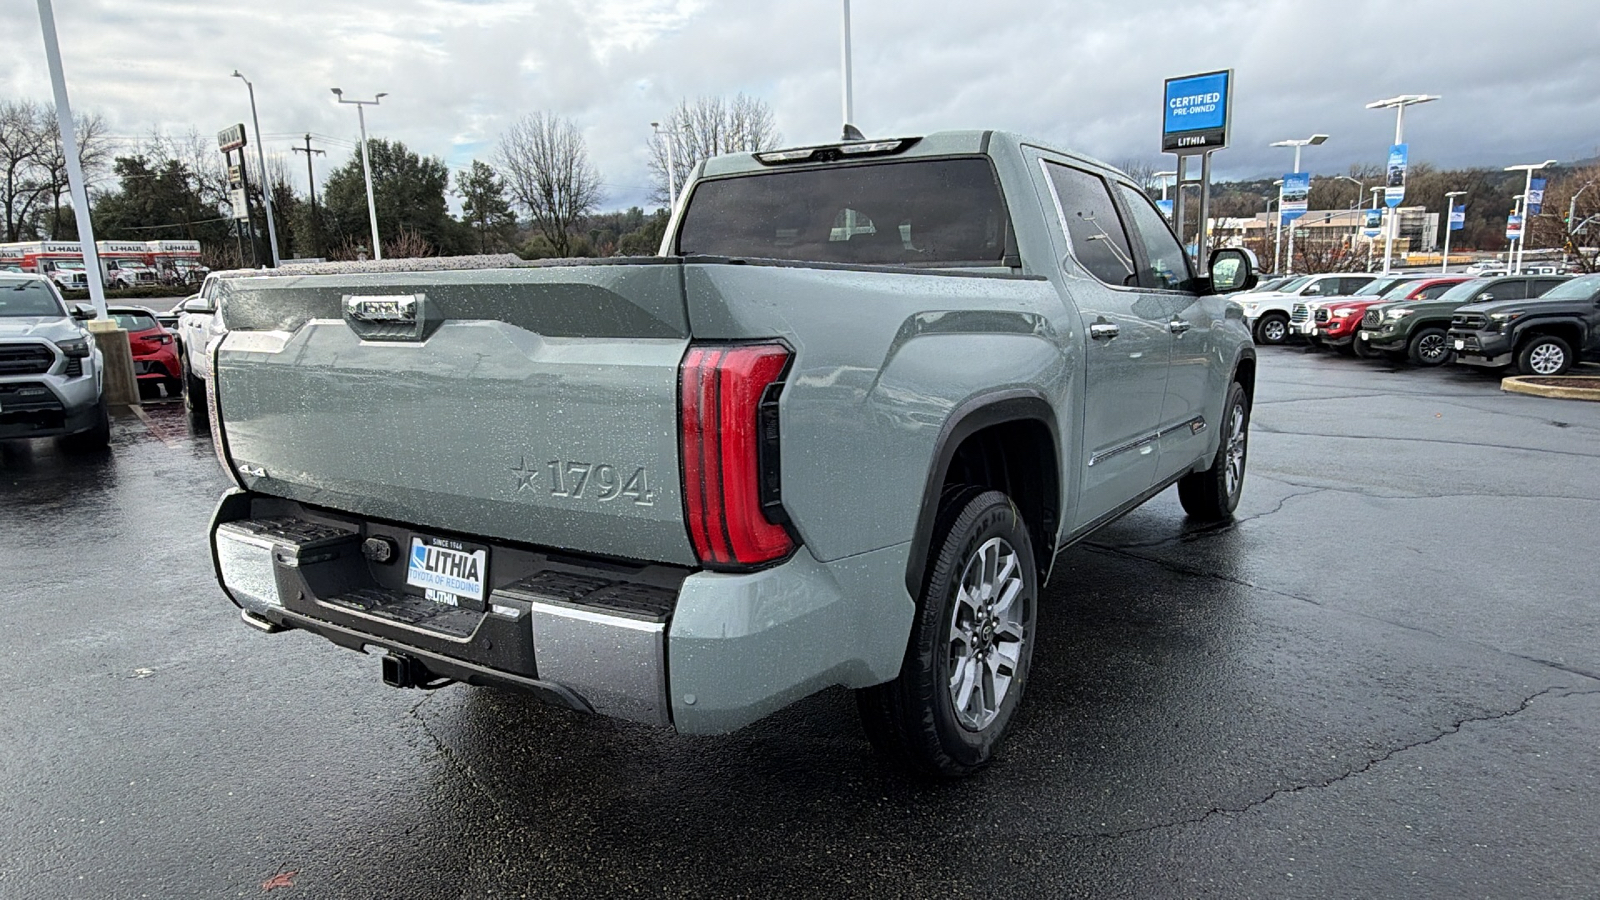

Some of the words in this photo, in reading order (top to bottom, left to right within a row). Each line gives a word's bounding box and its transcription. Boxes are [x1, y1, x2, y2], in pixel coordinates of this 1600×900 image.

[1169, 92, 1220, 109] CERTIFIED
[1173, 104, 1216, 117] PRE-OWNED
[1177, 135, 1206, 147] LITHIA
[547, 459, 654, 506] 1794
[432, 537, 449, 548] SINCE
[449, 540, 463, 550] 1946
[425, 548, 479, 582] LITHIA
[409, 568, 433, 583] TOYOTA
[434, 574, 444, 585] OF
[446, 577, 480, 594] REDDING
